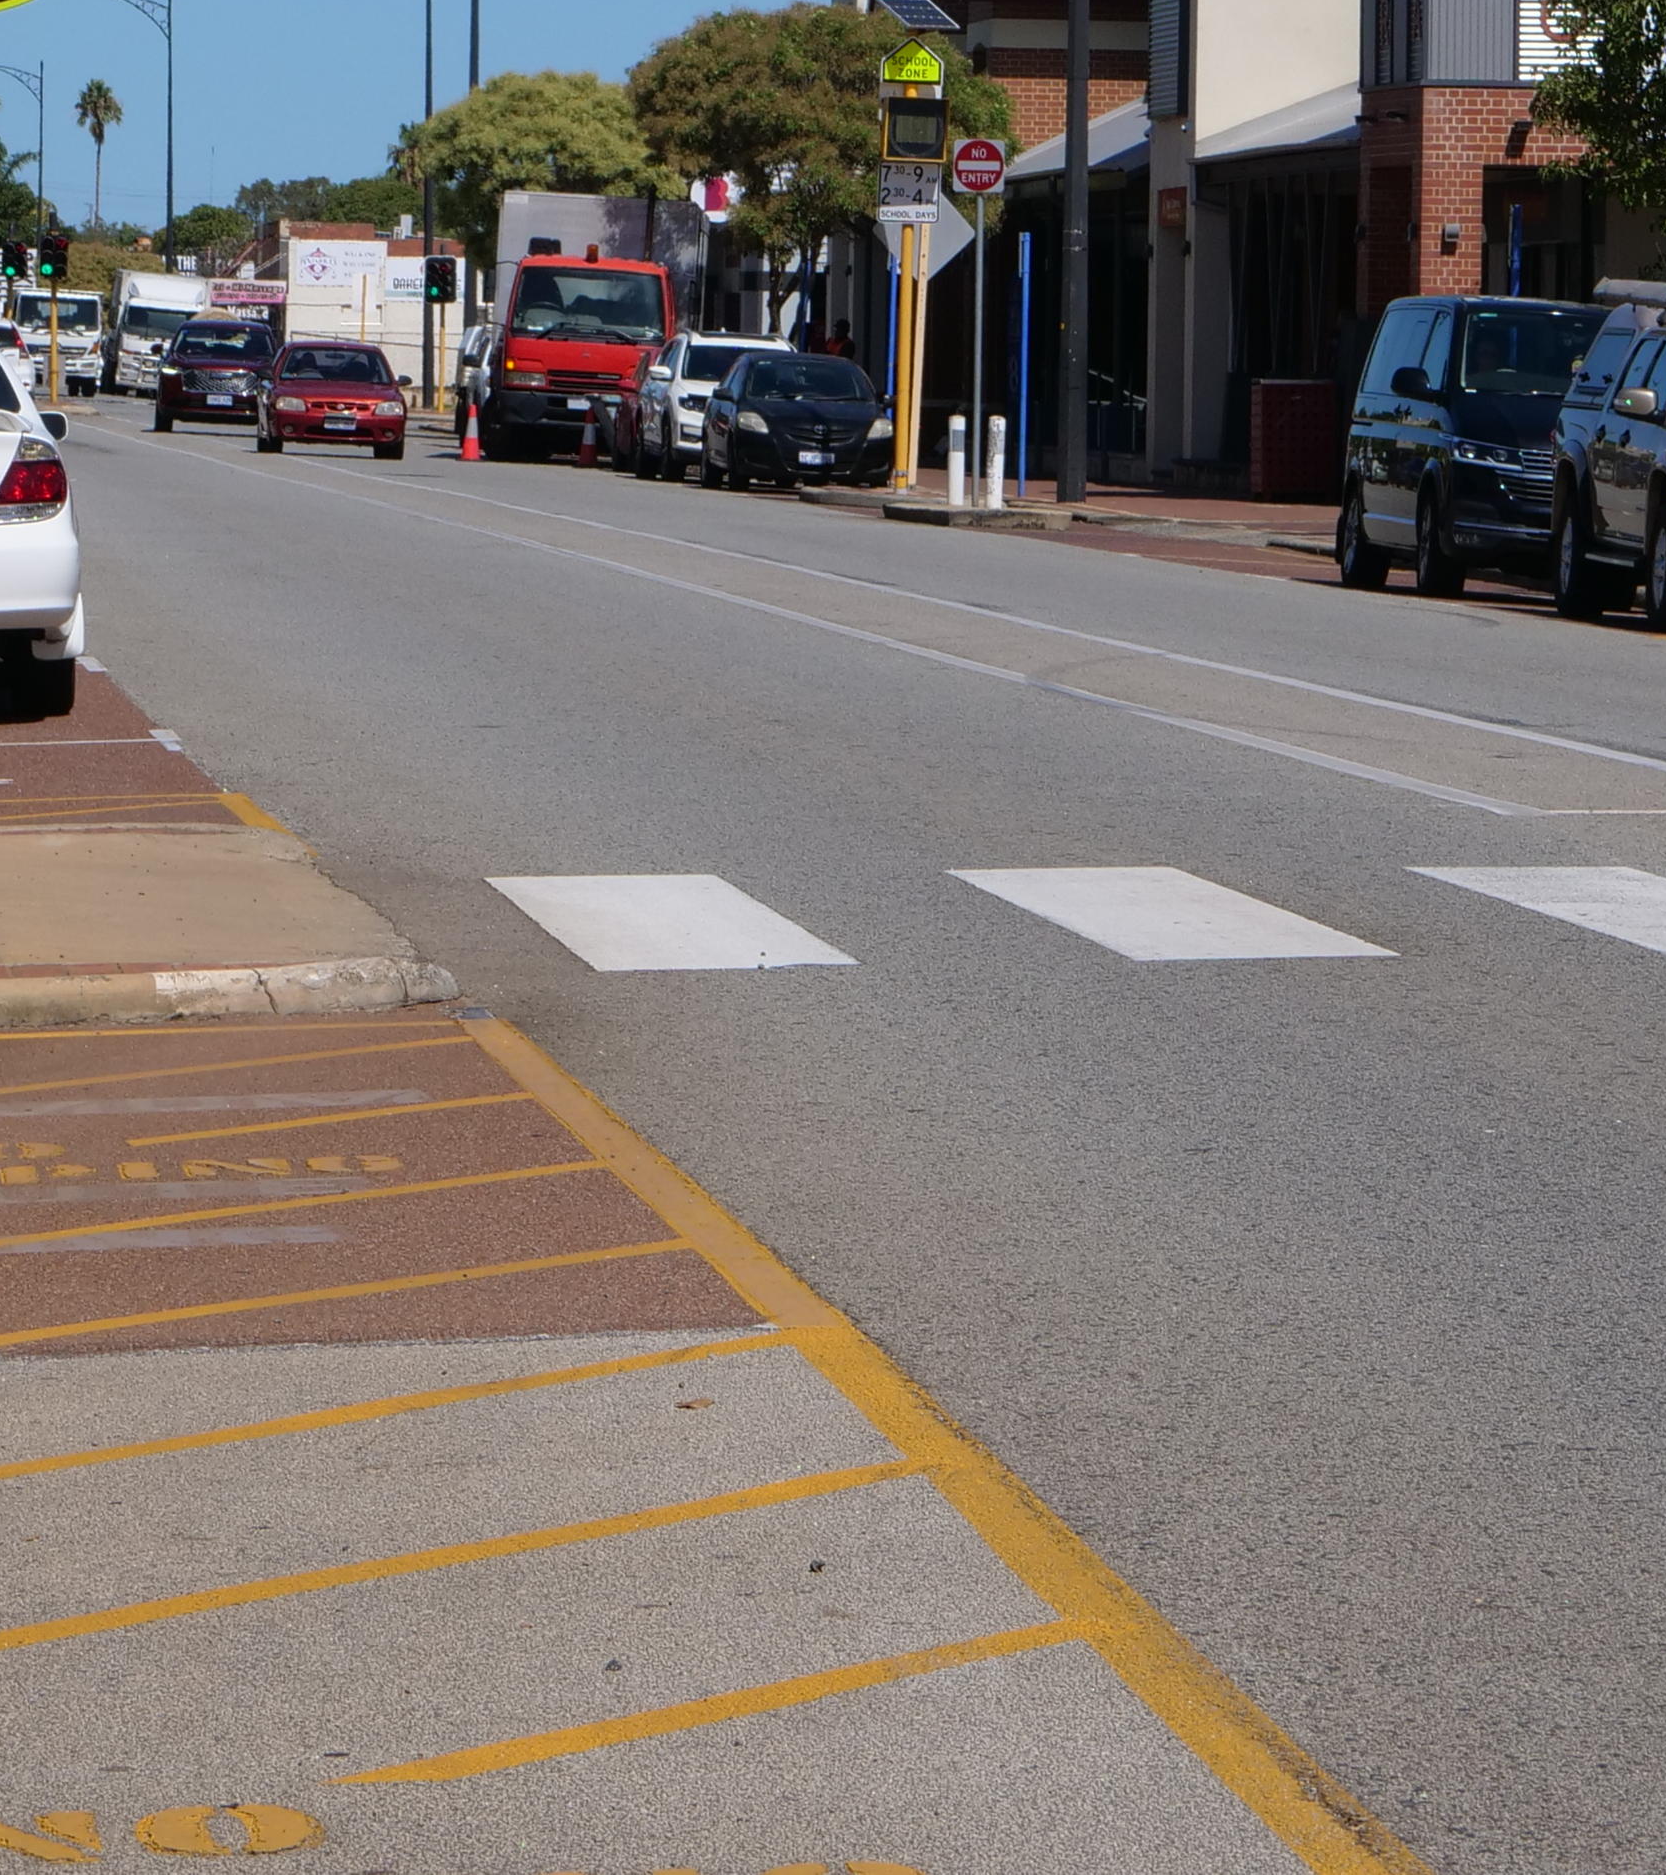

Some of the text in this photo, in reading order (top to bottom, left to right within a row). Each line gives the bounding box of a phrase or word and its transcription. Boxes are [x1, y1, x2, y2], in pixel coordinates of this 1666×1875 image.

[891, 56, 936, 68] SCHOOL
[897, 68, 929, 80] ZONE
[970, 147, 988, 159] NO
[961, 172, 997, 185] ENTRY
[880, 209, 937, 221] SCHOOL DAYS
